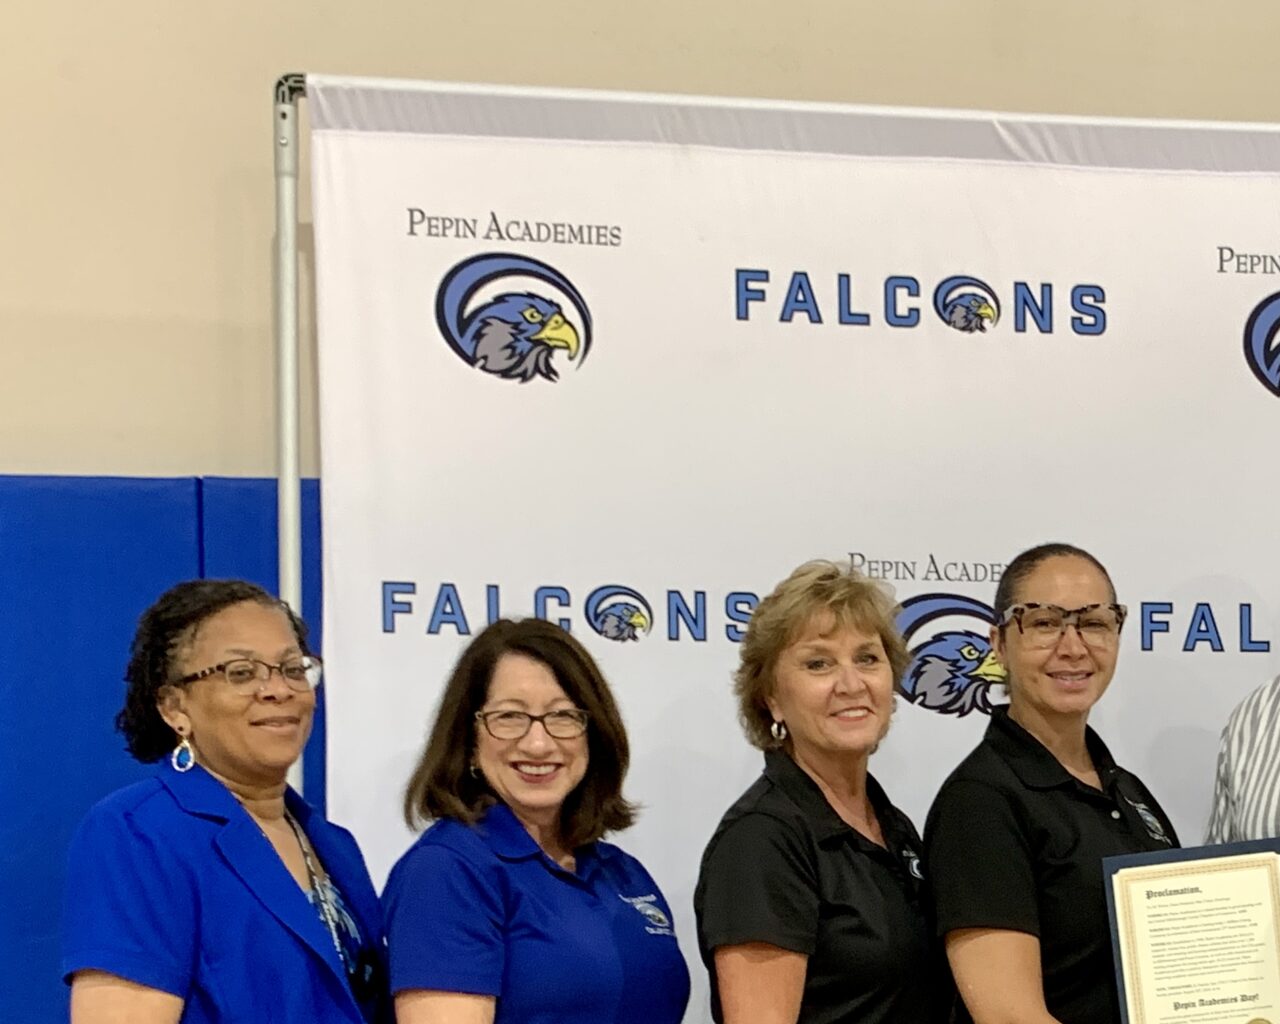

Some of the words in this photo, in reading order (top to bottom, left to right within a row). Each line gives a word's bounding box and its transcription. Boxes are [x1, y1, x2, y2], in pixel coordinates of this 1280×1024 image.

[407, 208, 477, 239] PEPIN
[482, 211, 622, 247] ACADEMIES
[735, 268, 1107, 336] FALCONS
[922, 553, 1005, 583] ACADE
